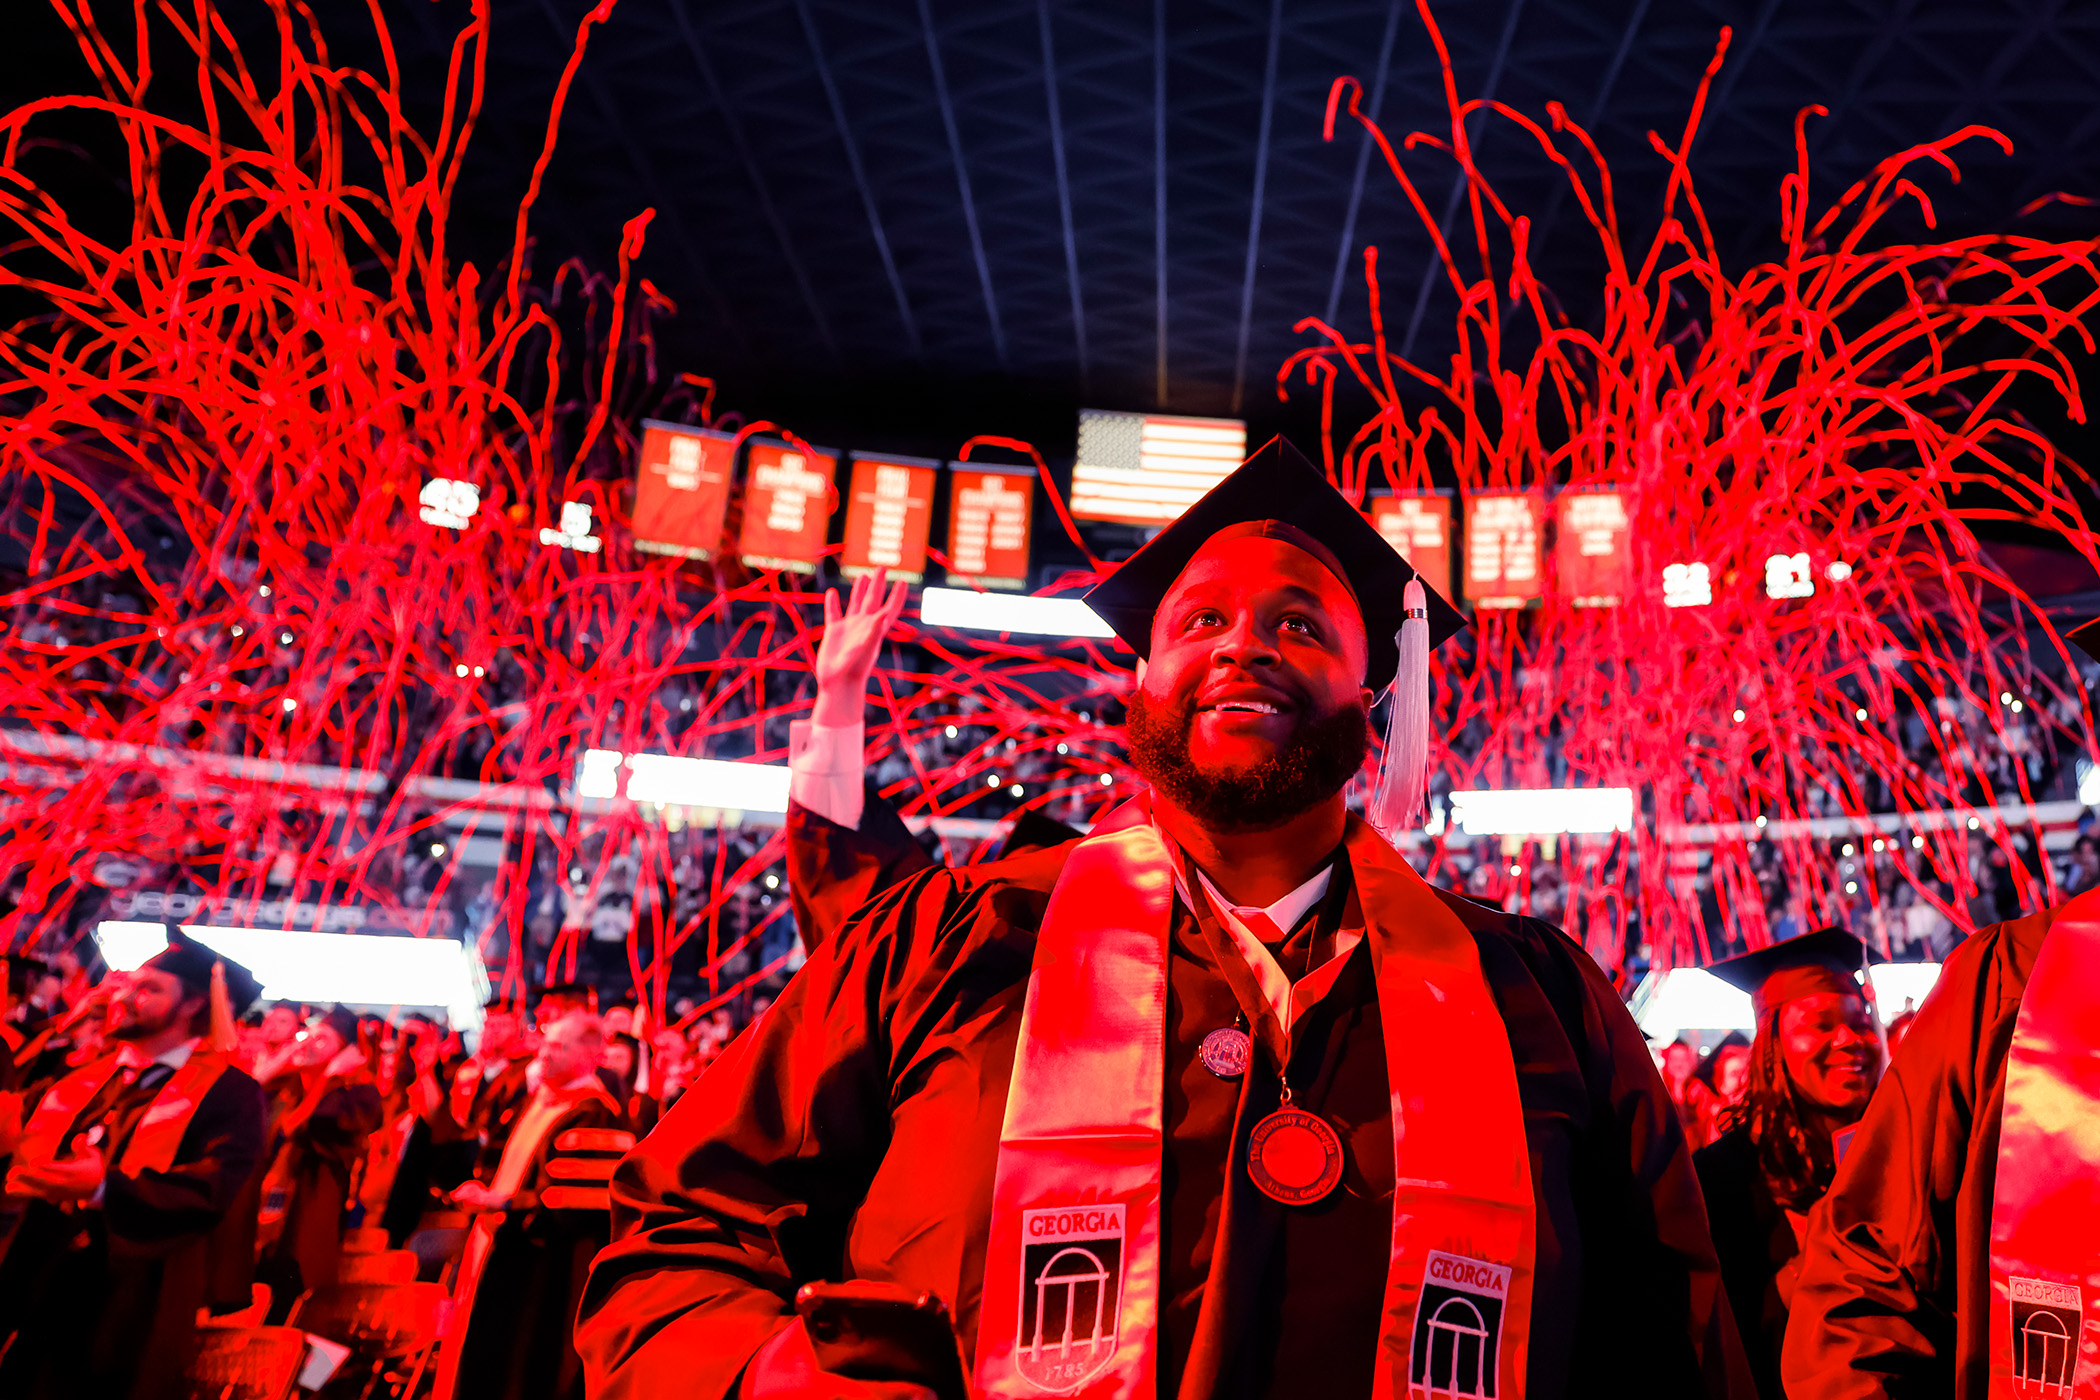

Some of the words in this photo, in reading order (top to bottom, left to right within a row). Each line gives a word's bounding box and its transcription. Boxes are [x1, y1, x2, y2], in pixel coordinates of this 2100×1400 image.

[1255, 1115, 1298, 1142] University
[1299, 1117, 1309, 1127] of
[1029, 1212, 1120, 1237] GEORGIA
[1430, 1257, 1503, 1291] GEORGIA
[2014, 1283, 2079, 1305] GEORGIA
[1045, 1363, 1085, 1381] 1785
